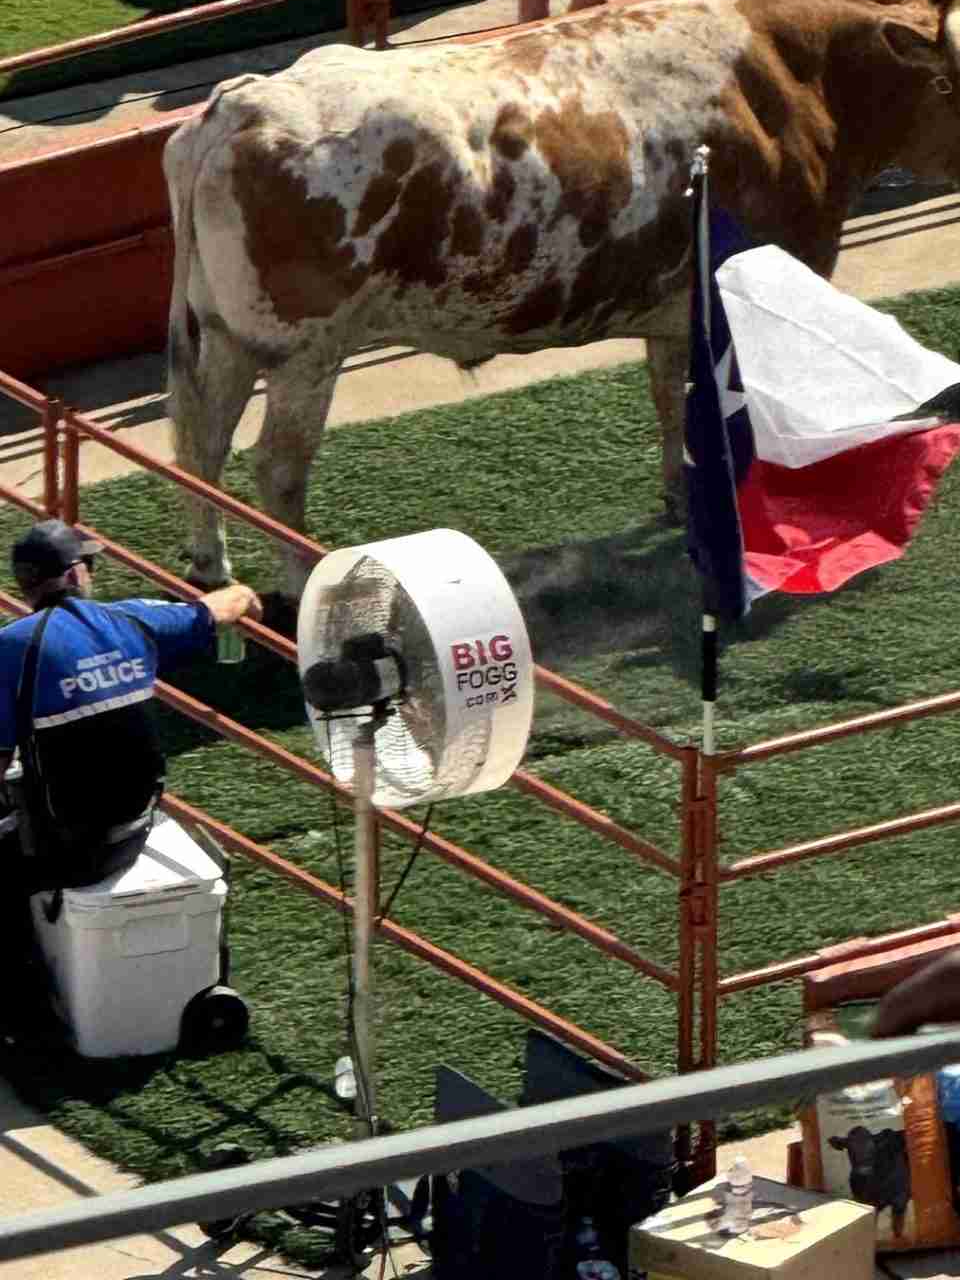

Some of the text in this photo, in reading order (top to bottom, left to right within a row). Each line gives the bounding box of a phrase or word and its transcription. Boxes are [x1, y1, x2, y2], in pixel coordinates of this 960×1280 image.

[450, 635, 513, 671] BIG
[60, 658, 147, 699] POLICE
[456, 662, 518, 691] FOGG
